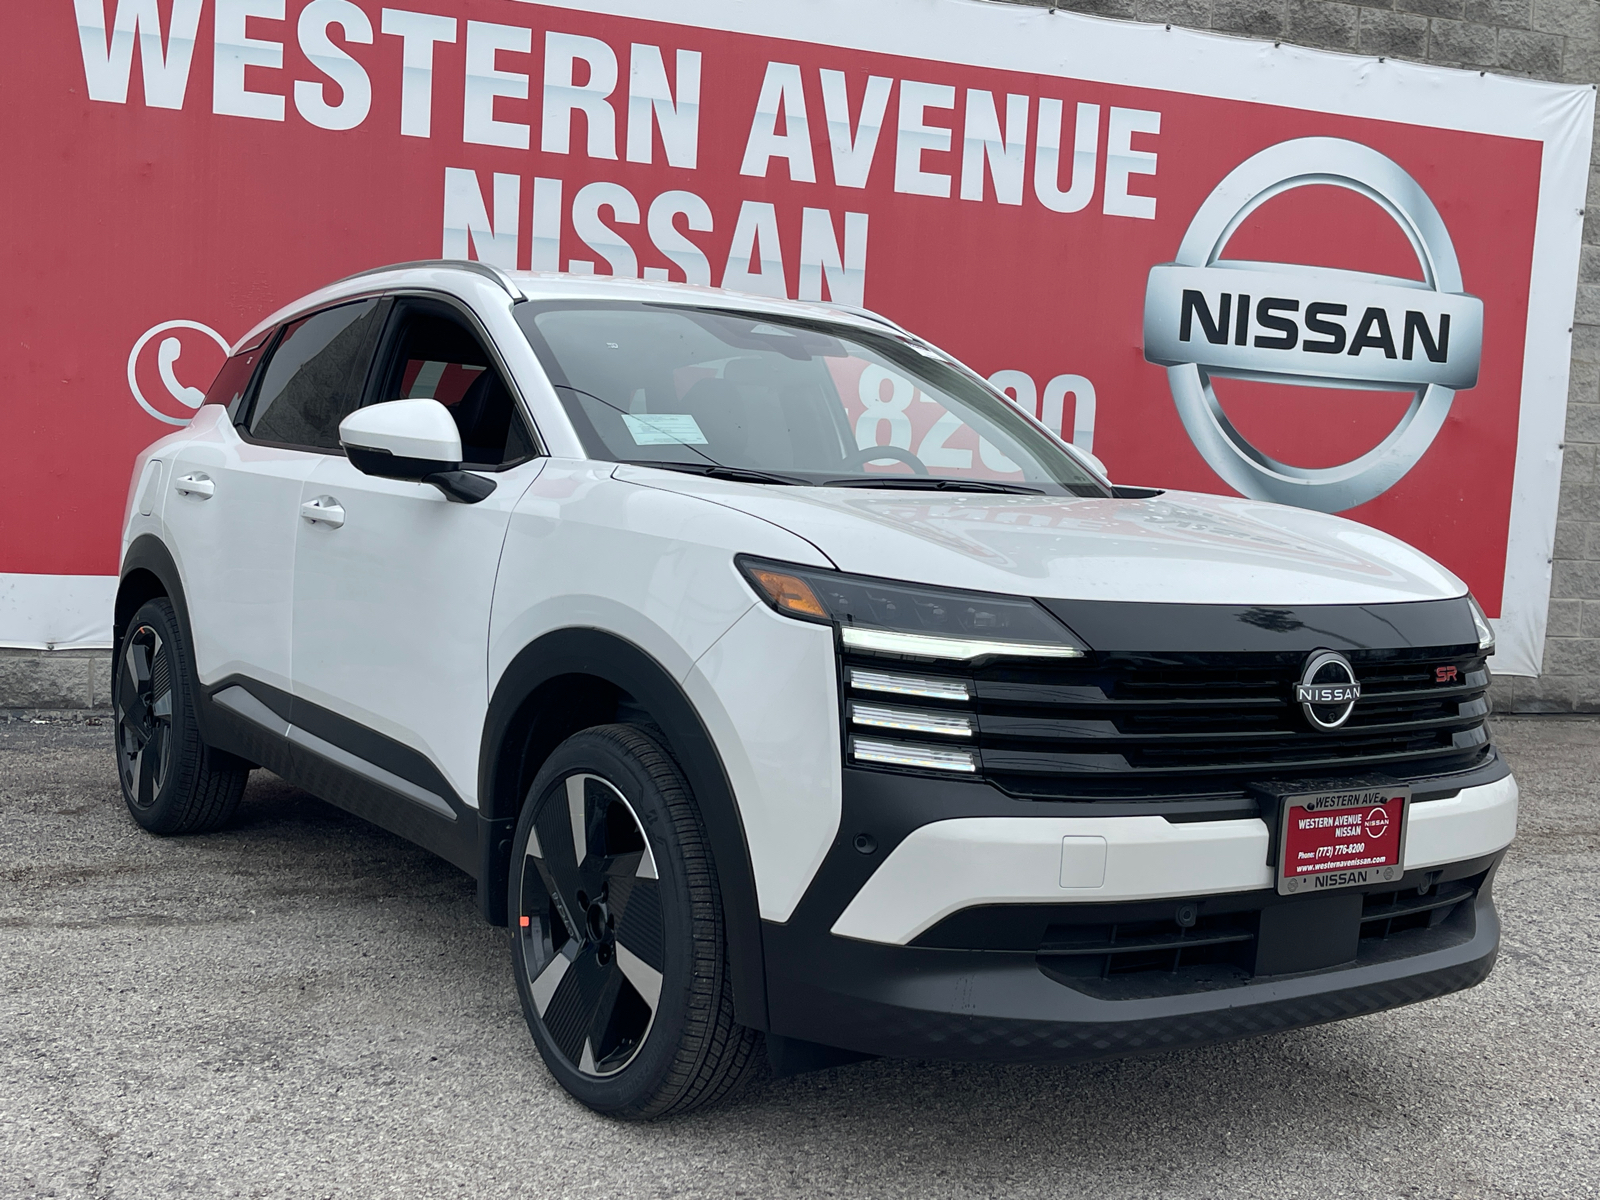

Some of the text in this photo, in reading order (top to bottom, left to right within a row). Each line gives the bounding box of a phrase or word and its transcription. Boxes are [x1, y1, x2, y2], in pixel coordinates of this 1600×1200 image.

[74, 0, 1161, 220] WESTERN AVENUE
[442, 166, 869, 308] NISSAN
[1179, 289, 1451, 363] NISSAN
[1436, 665, 1458, 682] SR
[1299, 686, 1361, 701] NISSAN
[1315, 794, 1361, 809] WESTERN
[1298, 814, 1362, 829] WESTERN AVENUE
[1364, 819, 1389, 827] NISSAN
[1335, 825, 1362, 838] NISSAN
[1315, 846, 1334, 859] (773)
[1334, 842, 1365, 856] 776-8200
[1296, 856, 1386, 872] www.westernavenissan.com
[1314, 871, 1367, 888] NISSAN
